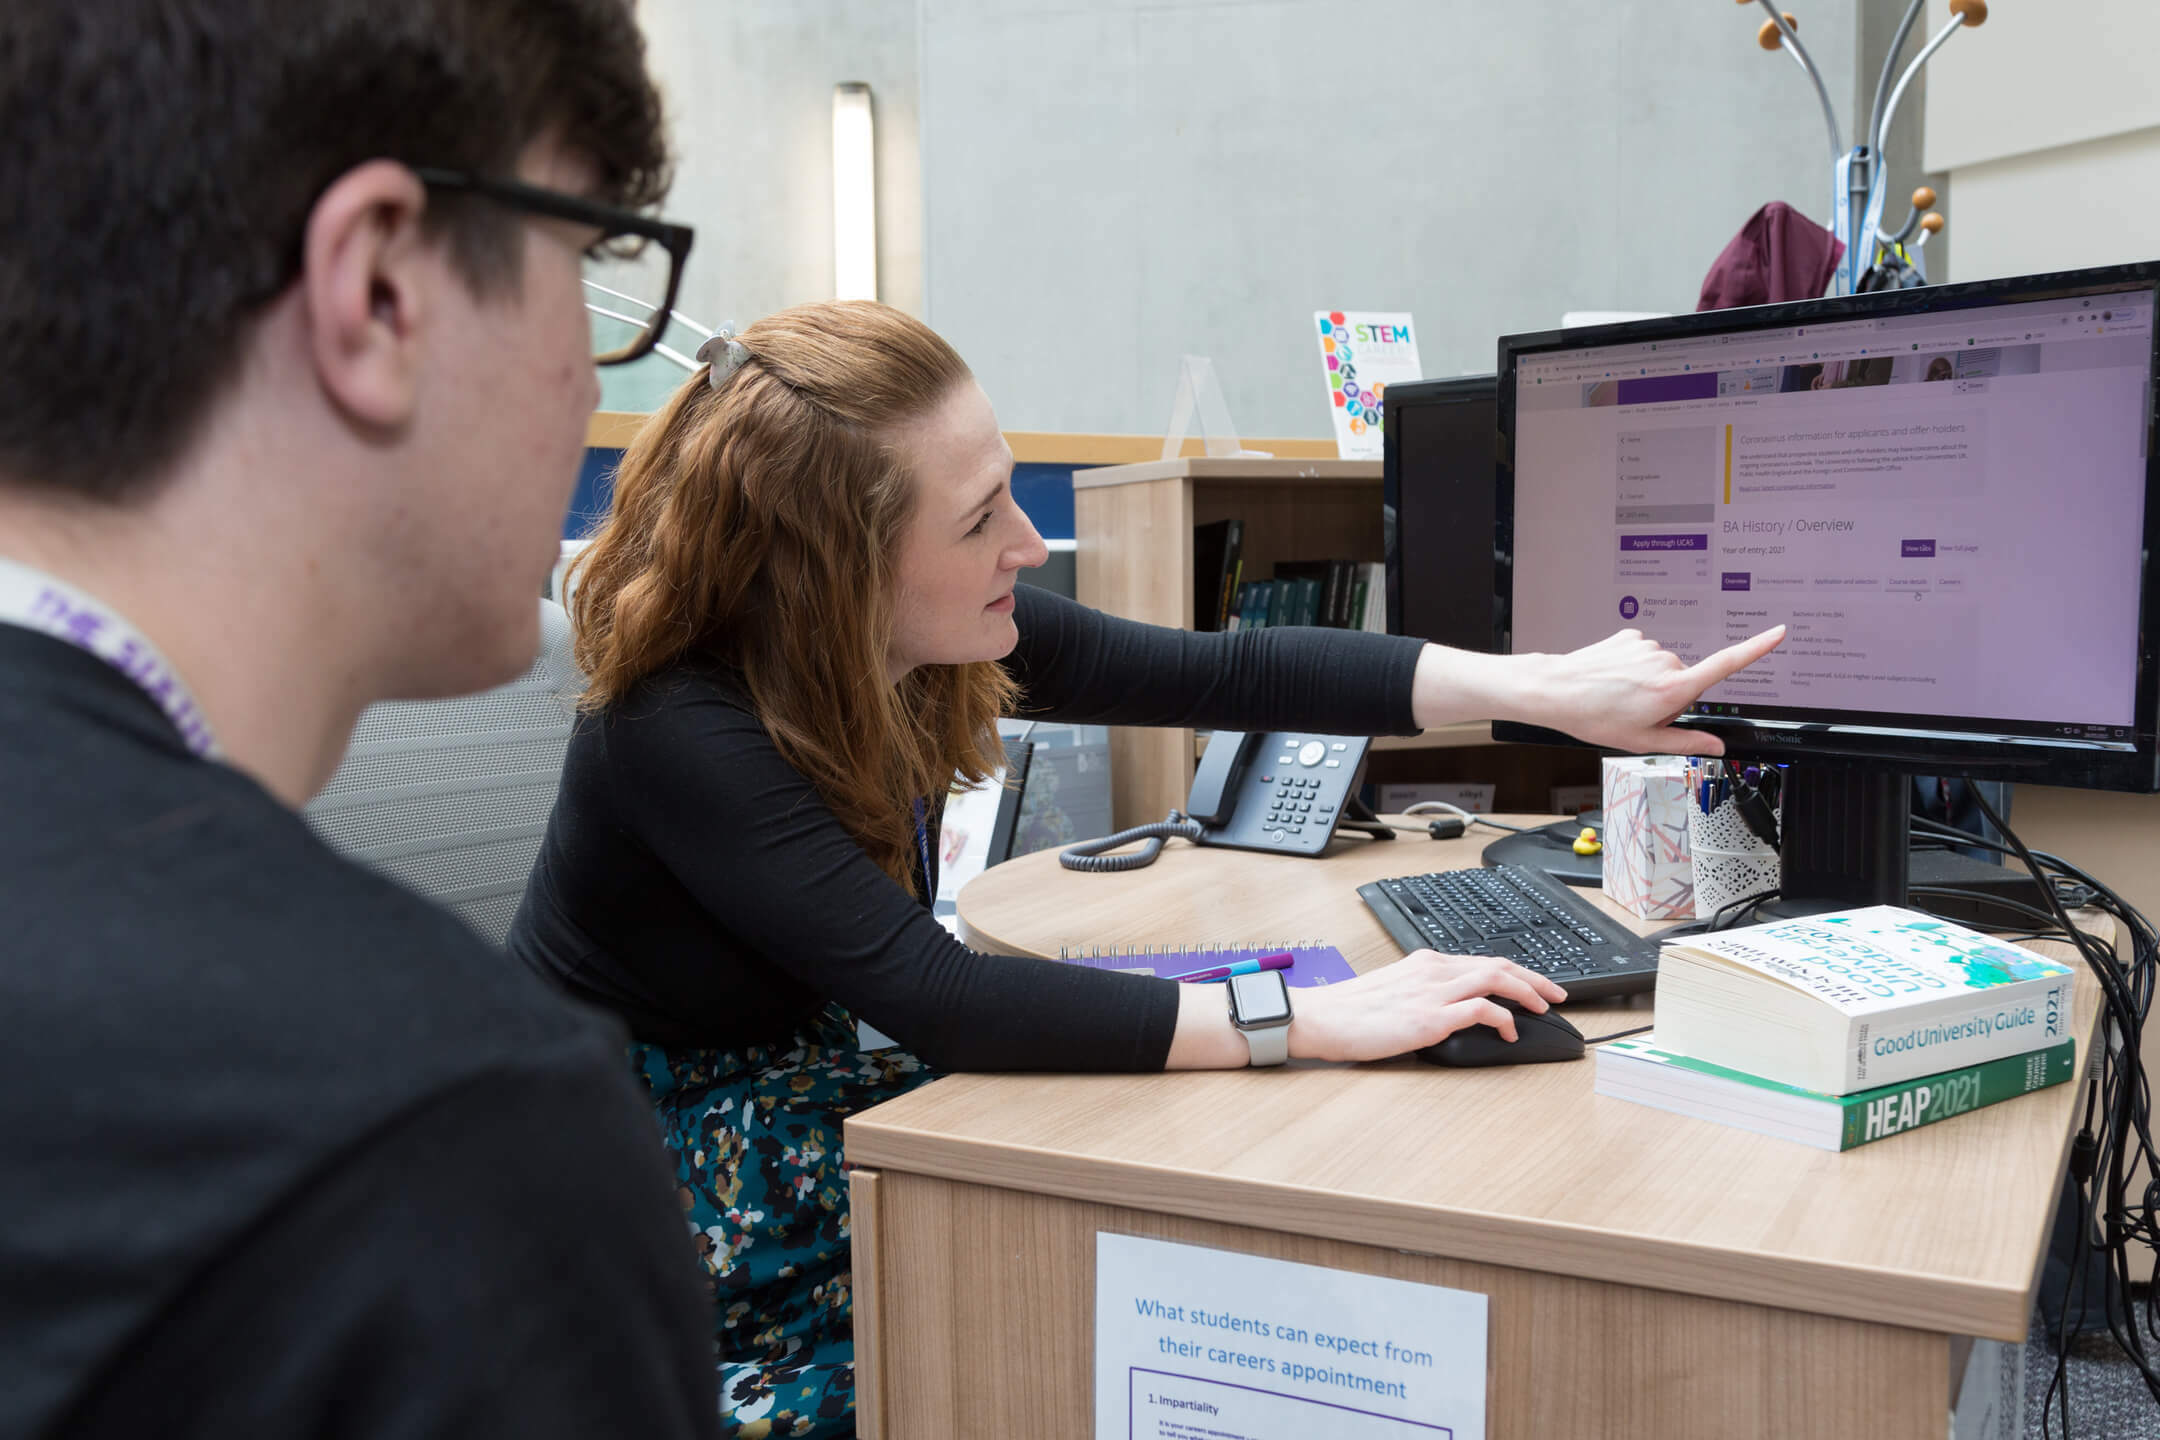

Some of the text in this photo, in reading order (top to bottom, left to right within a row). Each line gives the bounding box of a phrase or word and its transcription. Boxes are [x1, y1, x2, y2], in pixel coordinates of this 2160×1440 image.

[1355, 323, 1410, 344] STEM
[1723, 520, 1739, 533] BA
[1743, 519, 1785, 536] History
[1796, 518, 1855, 532] Overview
[1632, 538, 1694, 549] Apply through UCAS
[1722, 546, 1738, 555] Year
[1738, 546, 1746, 554] of
[1768, 545, 1785, 554] 2021
[1642, 597, 1698, 609] Attend an open
[1642, 608, 1656, 619] day
[1752, 730, 1804, 745] ViewSonic
[1752, 928, 1921, 993] University
[1781, 924, 1946, 989] Guide 2021
[1799, 955, 1896, 998] Good
[2045, 987, 2060, 1038] 2021
[1873, 1029, 1915, 1057] Good
[1917, 1015, 1994, 1048] University
[1994, 1006, 2036, 1032] Guide
[1134, 1297, 1433, 1368] What students can expect from
[1158, 1335, 1408, 1400] their careers appointment
[1148, 1393, 1220, 1416] 1. Impartiality
